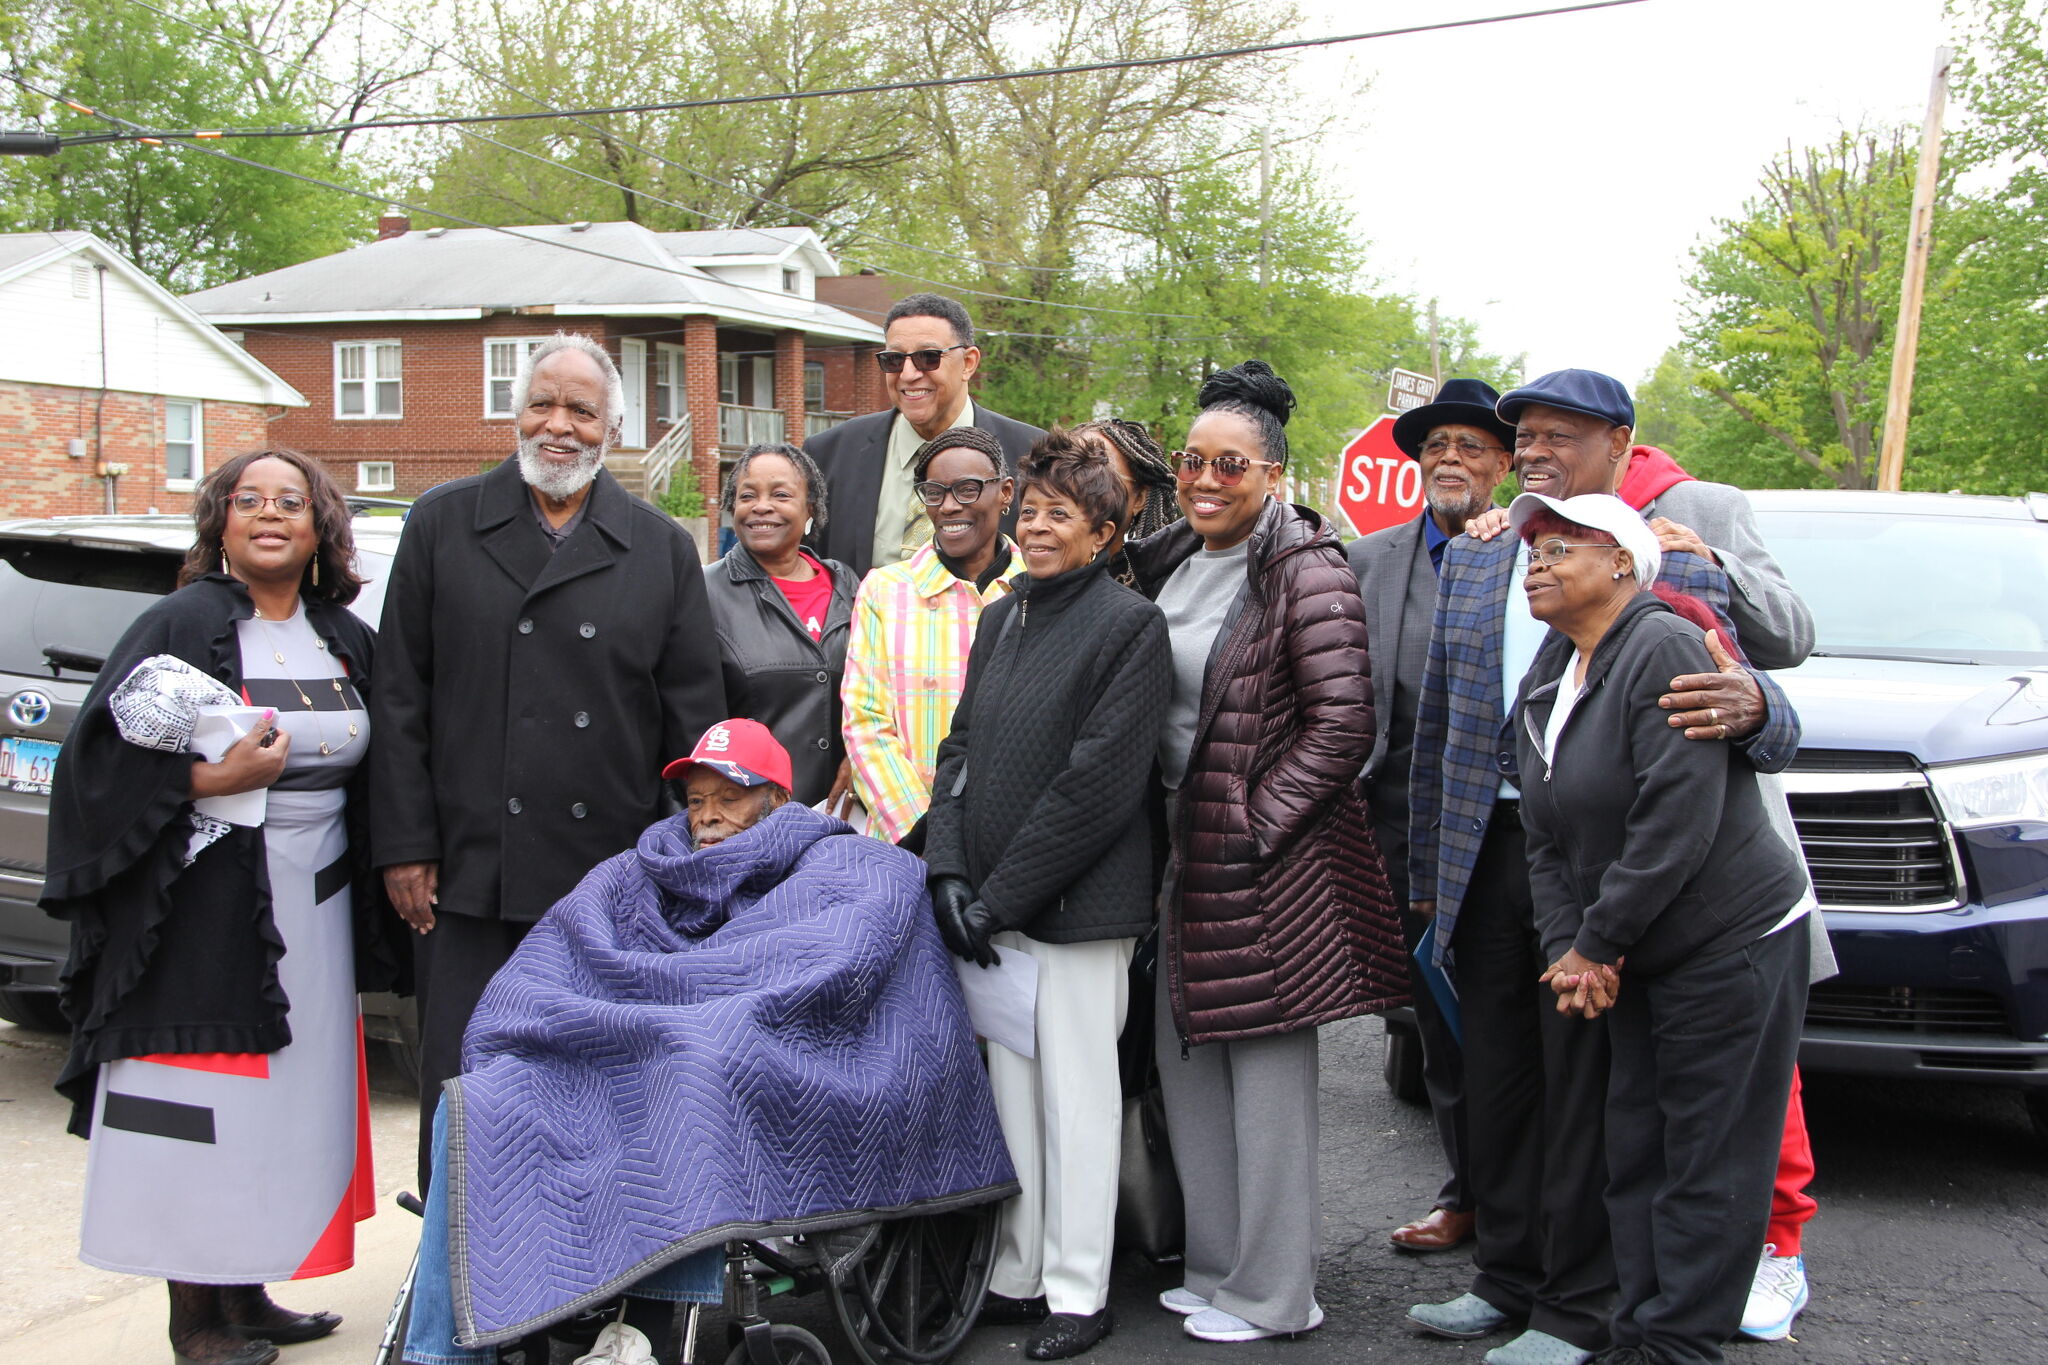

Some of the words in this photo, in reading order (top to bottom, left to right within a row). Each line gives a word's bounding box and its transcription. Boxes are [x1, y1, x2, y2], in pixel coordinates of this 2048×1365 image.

[1393, 373, 1415, 392] JAMES
[1417, 379, 1434, 397] GRAY
[1346, 455, 1425, 508] STO
[31, 755, 57, 782] 63
